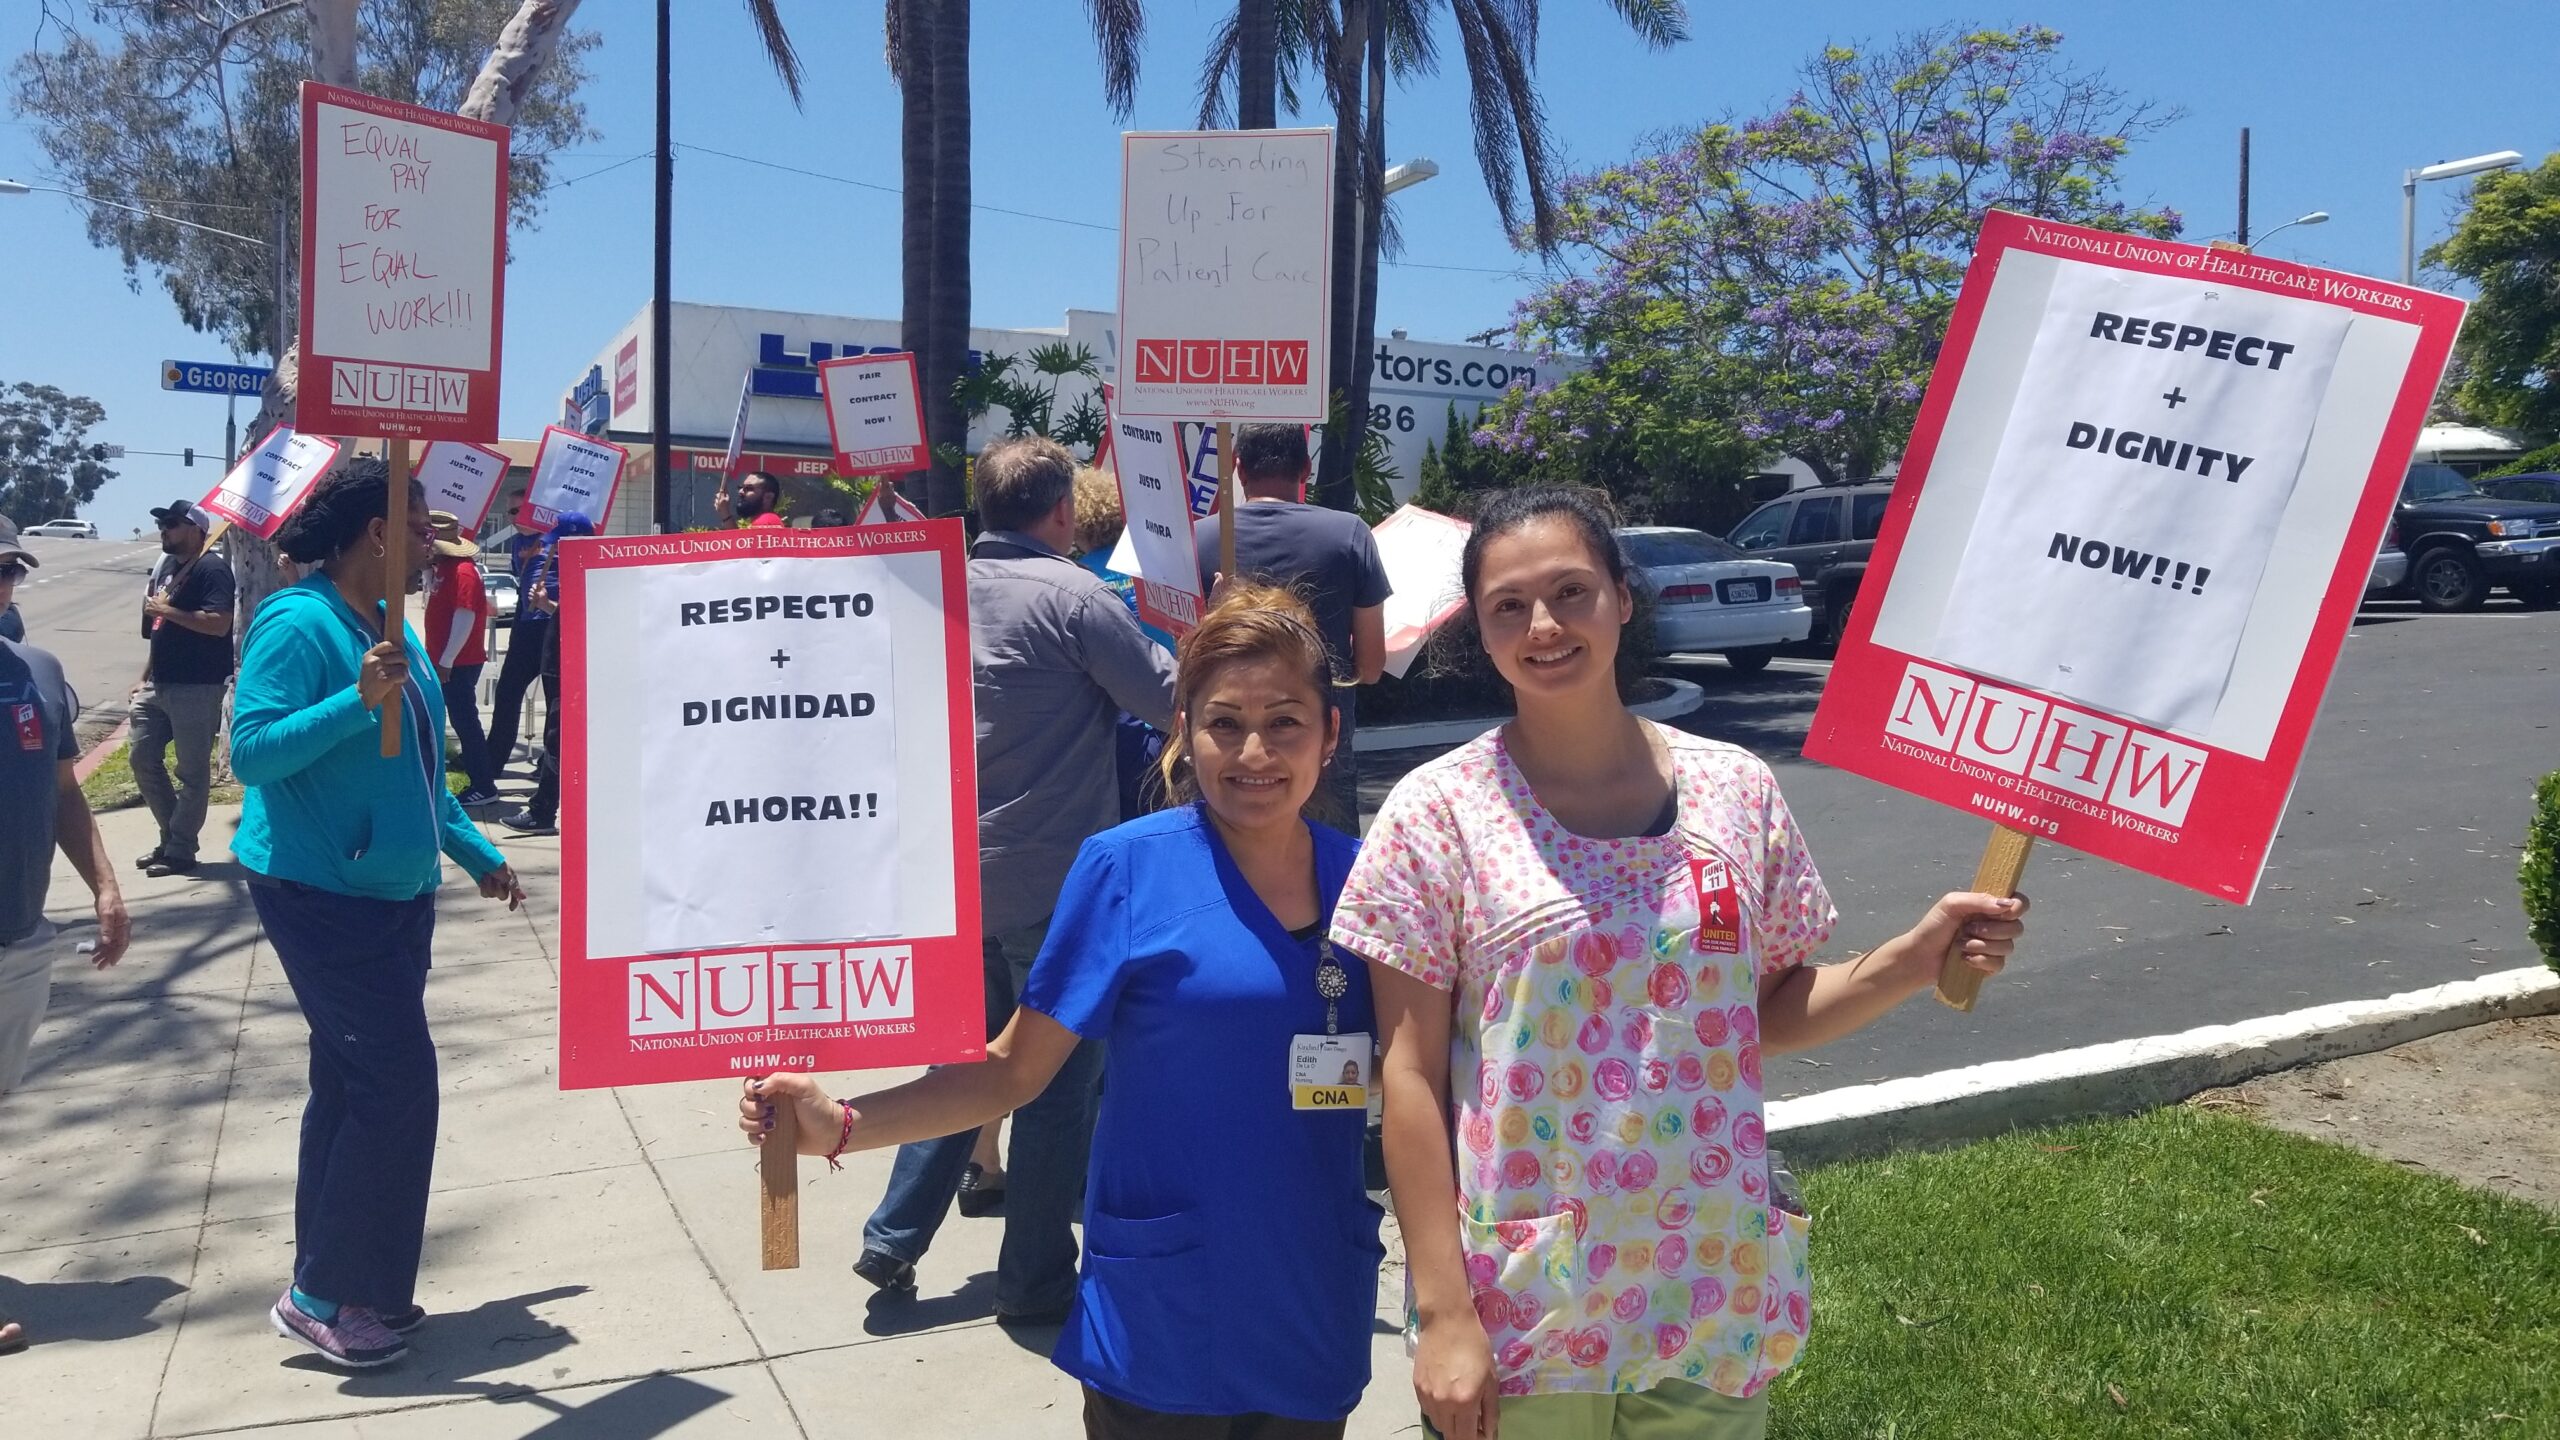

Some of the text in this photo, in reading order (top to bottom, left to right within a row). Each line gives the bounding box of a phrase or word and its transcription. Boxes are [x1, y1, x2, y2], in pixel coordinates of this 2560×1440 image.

[340, 122, 431, 163] EQUAL
[1160, 141, 1309, 181] Standing
[390, 163, 430, 194] PAY
[364, 204, 402, 232] FOR
[1167, 191, 1277, 233] Up For
[338, 242, 438, 288] EQUAL
[1137, 237, 1318, 286] Patient Care
[2024, 224, 2413, 312] NATIONAL UNION OF HEALTHCARE WORKERS
[367, 289, 471, 334] WORK!!!
[2089, 311, 2295, 371] RESPECT
[1139, 345, 1307, 379] NUHW
[859, 372, 881, 380] FAIR
[334, 368, 467, 407] NUHW
[849, 393, 897, 404] CONTRACT
[2161, 386, 2188, 409] +
[1185, 399, 1256, 409] www.NUHW.org
[379, 422, 422, 433] NUHW.org
[864, 416, 886, 425] NOW
[288, 437, 306, 449] FAIR
[1122, 423, 1162, 444] CONTRATO
[265, 451, 302, 471] CONTRACT
[464, 453, 477, 463] NO
[566, 443, 610, 461] CONTRATO
[694, 455, 728, 469] OLV
[852, 448, 912, 466] NUHW
[2066, 421, 2255, 483] DIGNITY
[569, 465, 595, 478] JUSTO
[794, 461, 829, 475] JEEP
[452, 481, 464, 490] NO
[561, 483, 591, 498] AHORA
[1138, 473, 1161, 490] JUSTO
[441, 488, 466, 503] PEACE
[217, 492, 268, 522] NUHW
[1145, 519, 1172, 539] AHORA
[598, 530, 927, 559] NATIONAL UNION OF HEALTHCARE WORKERS
[2046, 532, 2212, 596] NOW!!!
[680, 592, 874, 626] RESPECTO
[1145, 581, 1195, 622] NUHW
[769, 648, 792, 669] +
[682, 692, 876, 727] DIGNIDAD
[1895, 674, 2202, 810] NUHW
[1880, 735, 2180, 845] NATIONAL UNION OF HEALTHCARE WORKERS
[704, 792, 879, 826] AHORA!!
[1971, 792, 2060, 835] NUHW.org
[1704, 862, 1724, 878] JUNE
[1708, 875, 1720, 888] 11
[1703, 928, 1736, 940] UNITED
[632, 955, 910, 1023] NUHW
[629, 1022, 916, 1053] NATIONAL UNION OF HEALTHCARE WORKERS
[730, 1053, 815, 1071] NUHW.org
[1297, 1055, 1317, 1063] Edith
[1312, 1090, 1349, 1105] CNA
